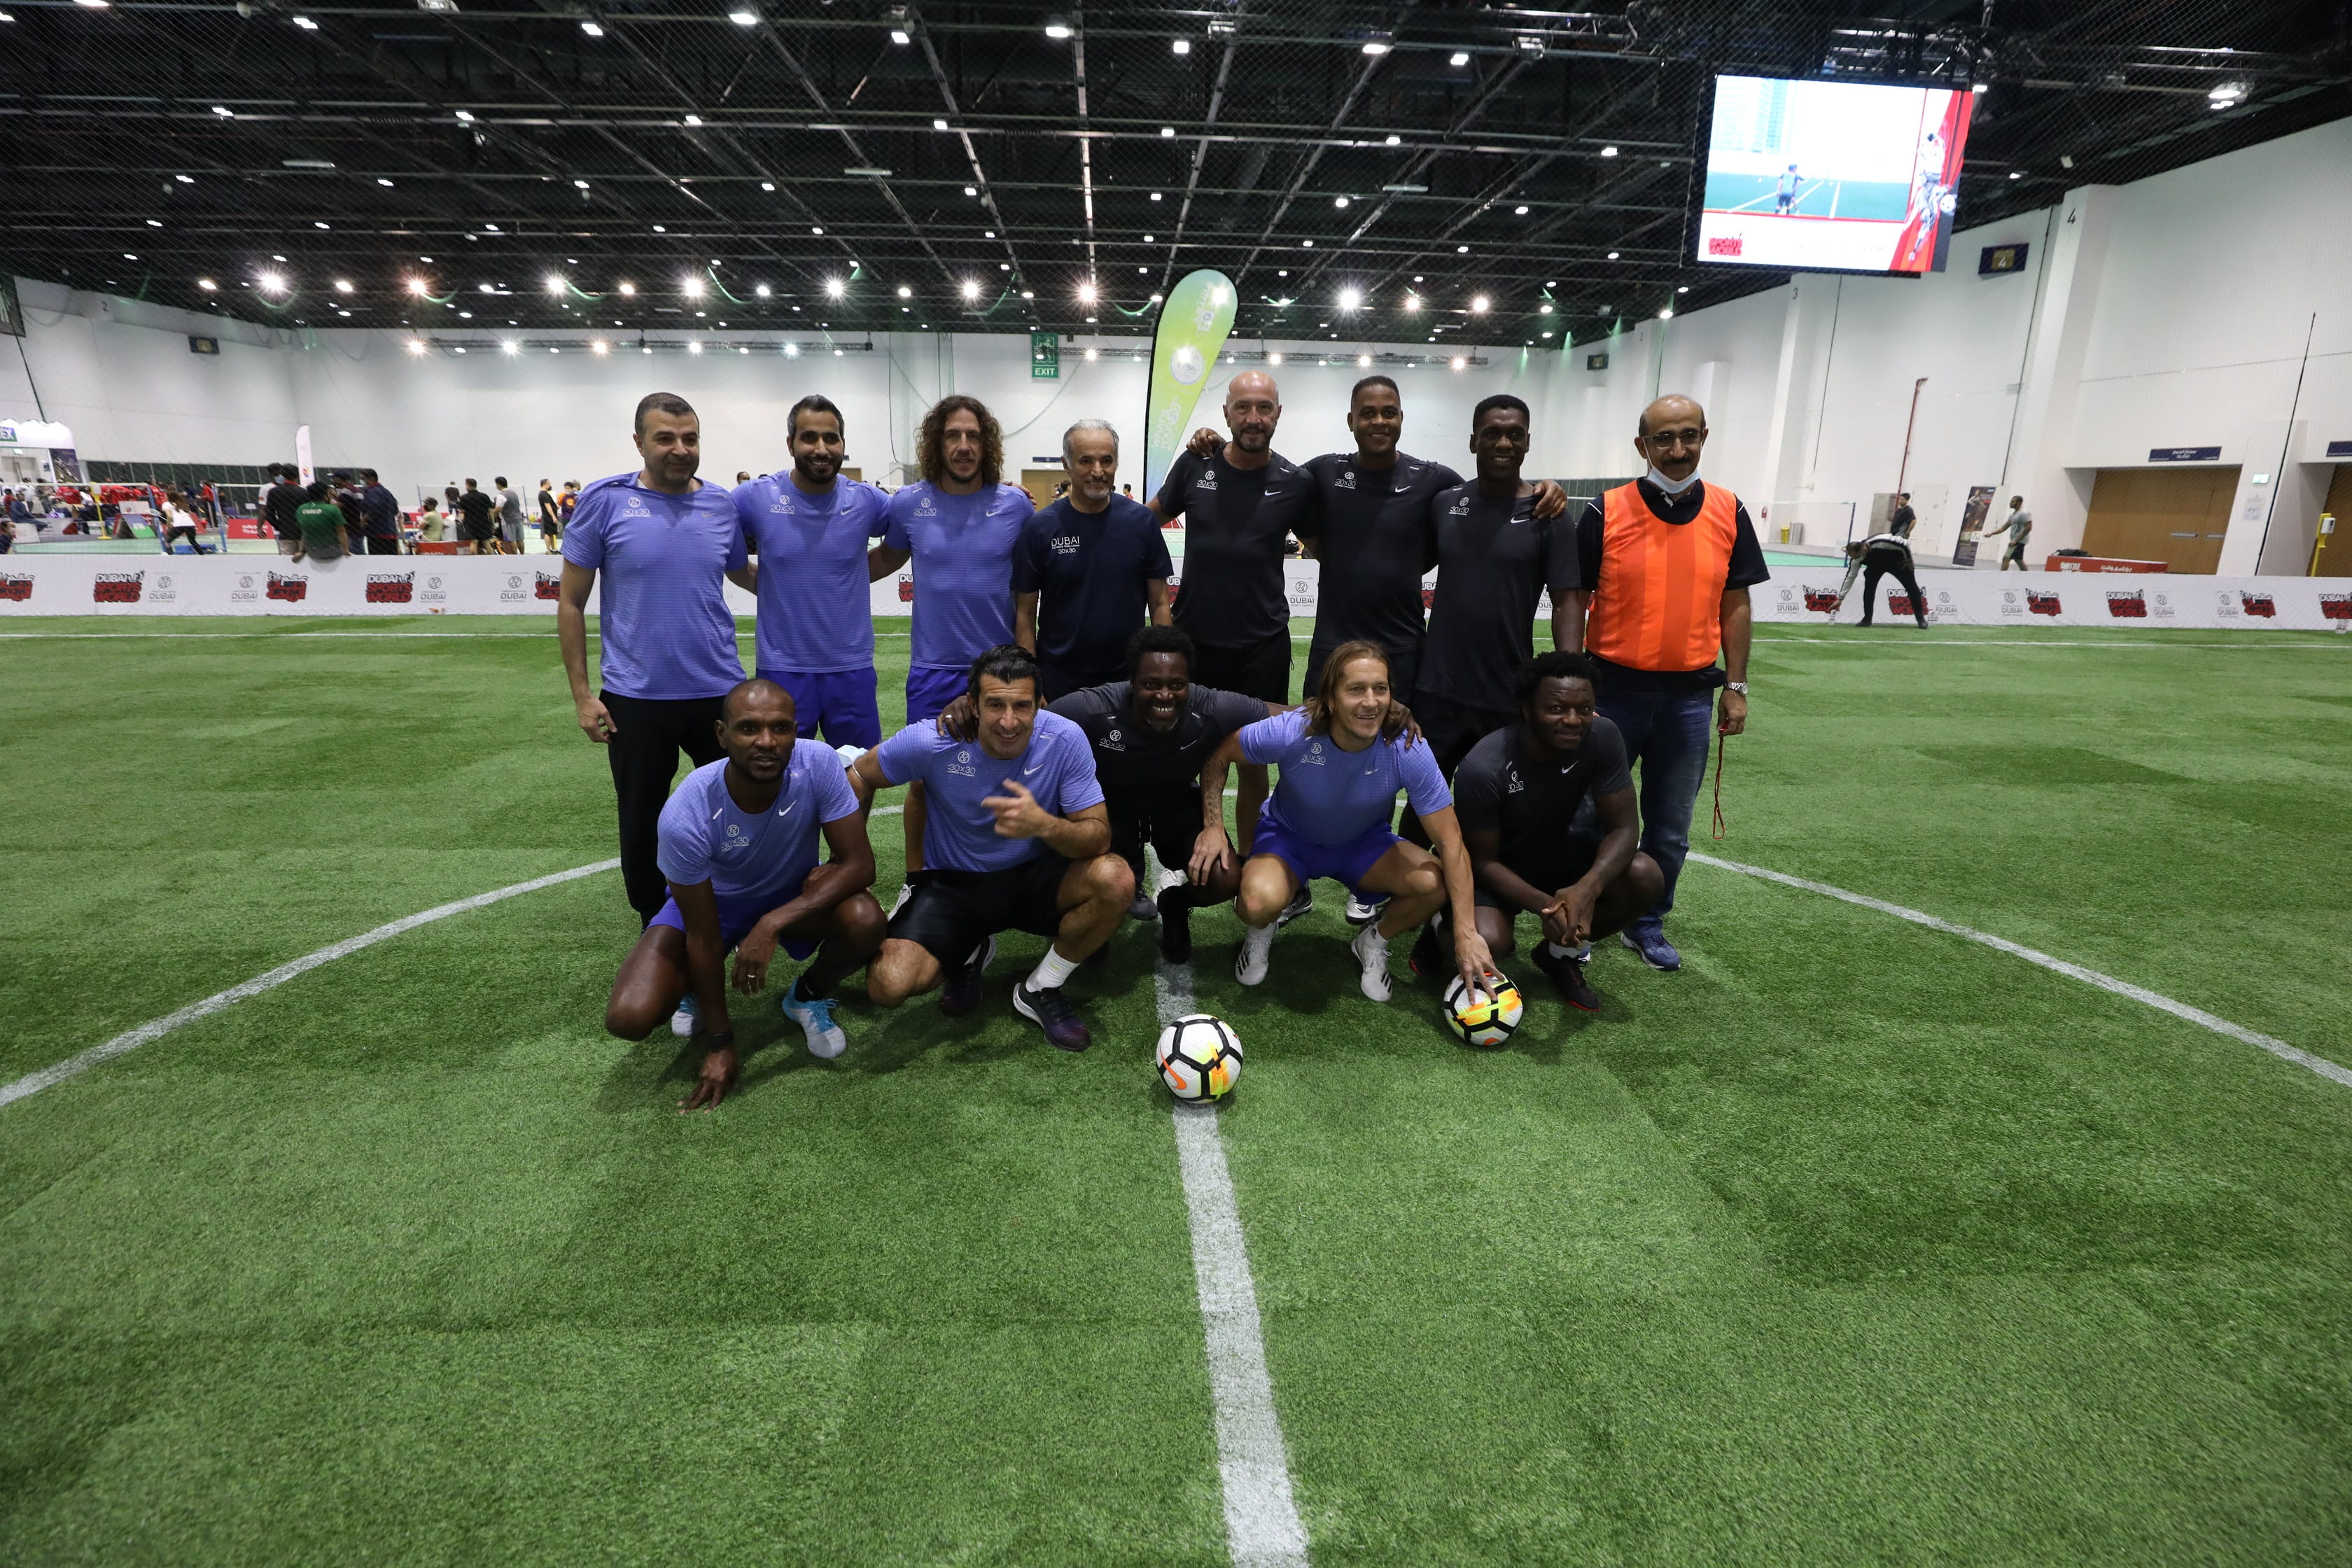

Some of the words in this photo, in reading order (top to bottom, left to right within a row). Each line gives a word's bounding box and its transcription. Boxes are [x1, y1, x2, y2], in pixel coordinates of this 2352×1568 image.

[1709, 238, 1742, 247] SPORTS
[1709, 246, 1742, 256] WORLD
[1035, 368, 1055, 376] EXIT
[1336, 478, 1357, 487] 30x30
[1051, 536, 1079, 547] DUBAI
[95, 573, 130, 583] DUBAI
[368, 574, 400, 583] DUBAI
[366, 592, 412, 603] WORLD
[1100, 738, 1126, 750] 30x30
[947, 763, 976, 774] 30x30
[722, 836, 749, 850] 30x30
